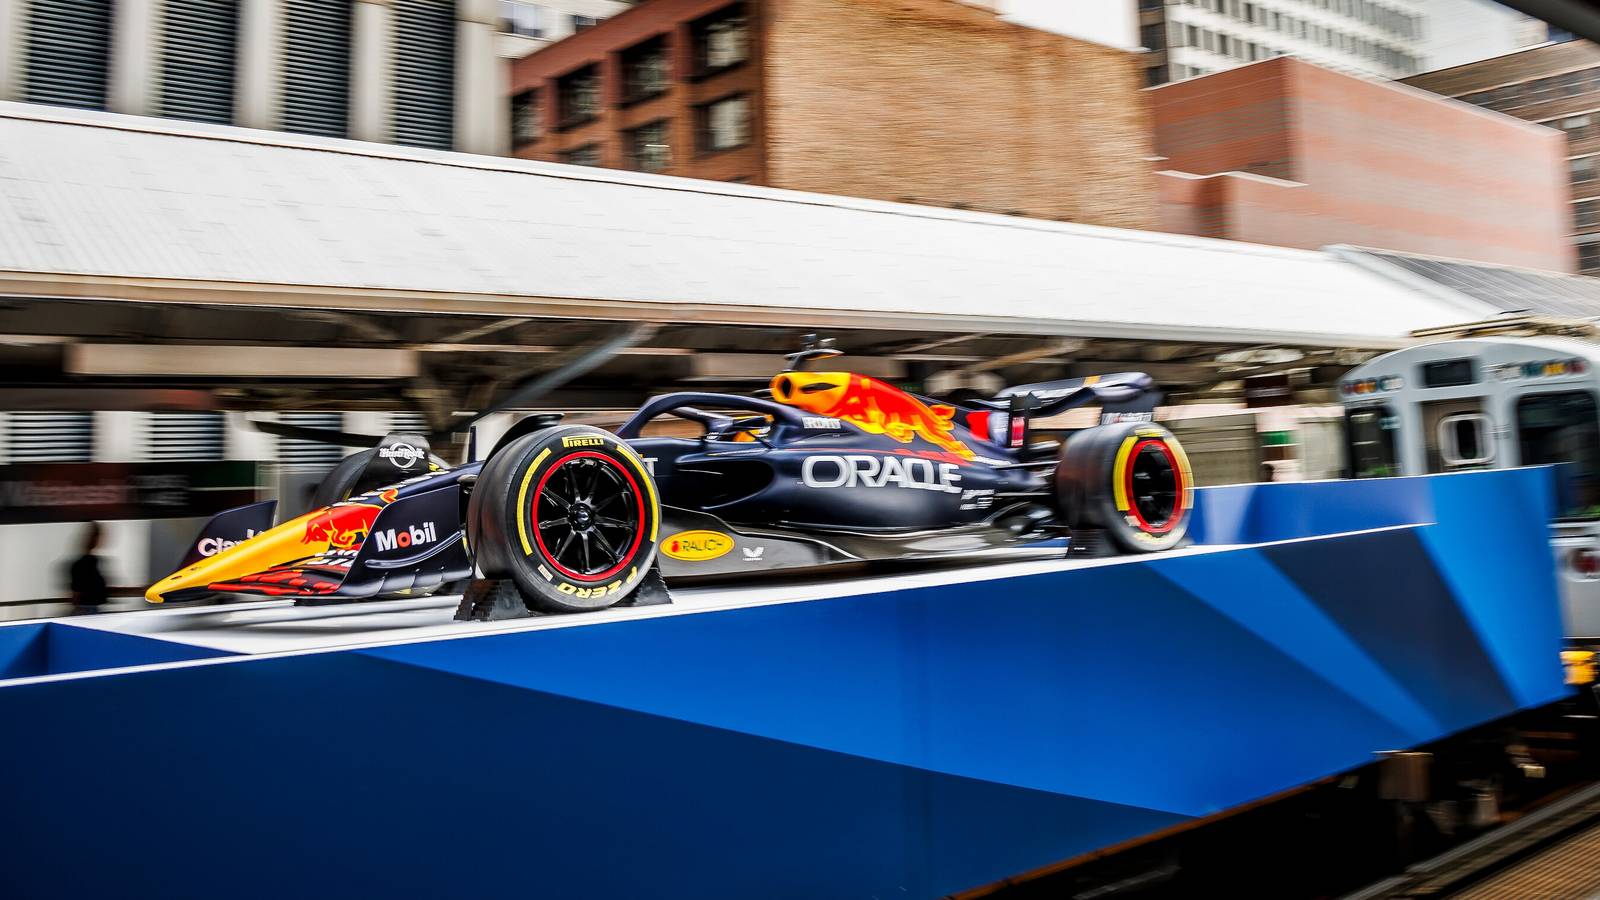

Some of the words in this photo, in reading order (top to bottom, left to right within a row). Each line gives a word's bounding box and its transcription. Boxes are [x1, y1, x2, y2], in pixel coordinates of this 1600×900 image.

[561, 435, 605, 448] PIRELLI
[801, 455, 962, 493] ORACLE
[374, 521, 437, 552] Mobil
[555, 579, 623, 599] ZERO
